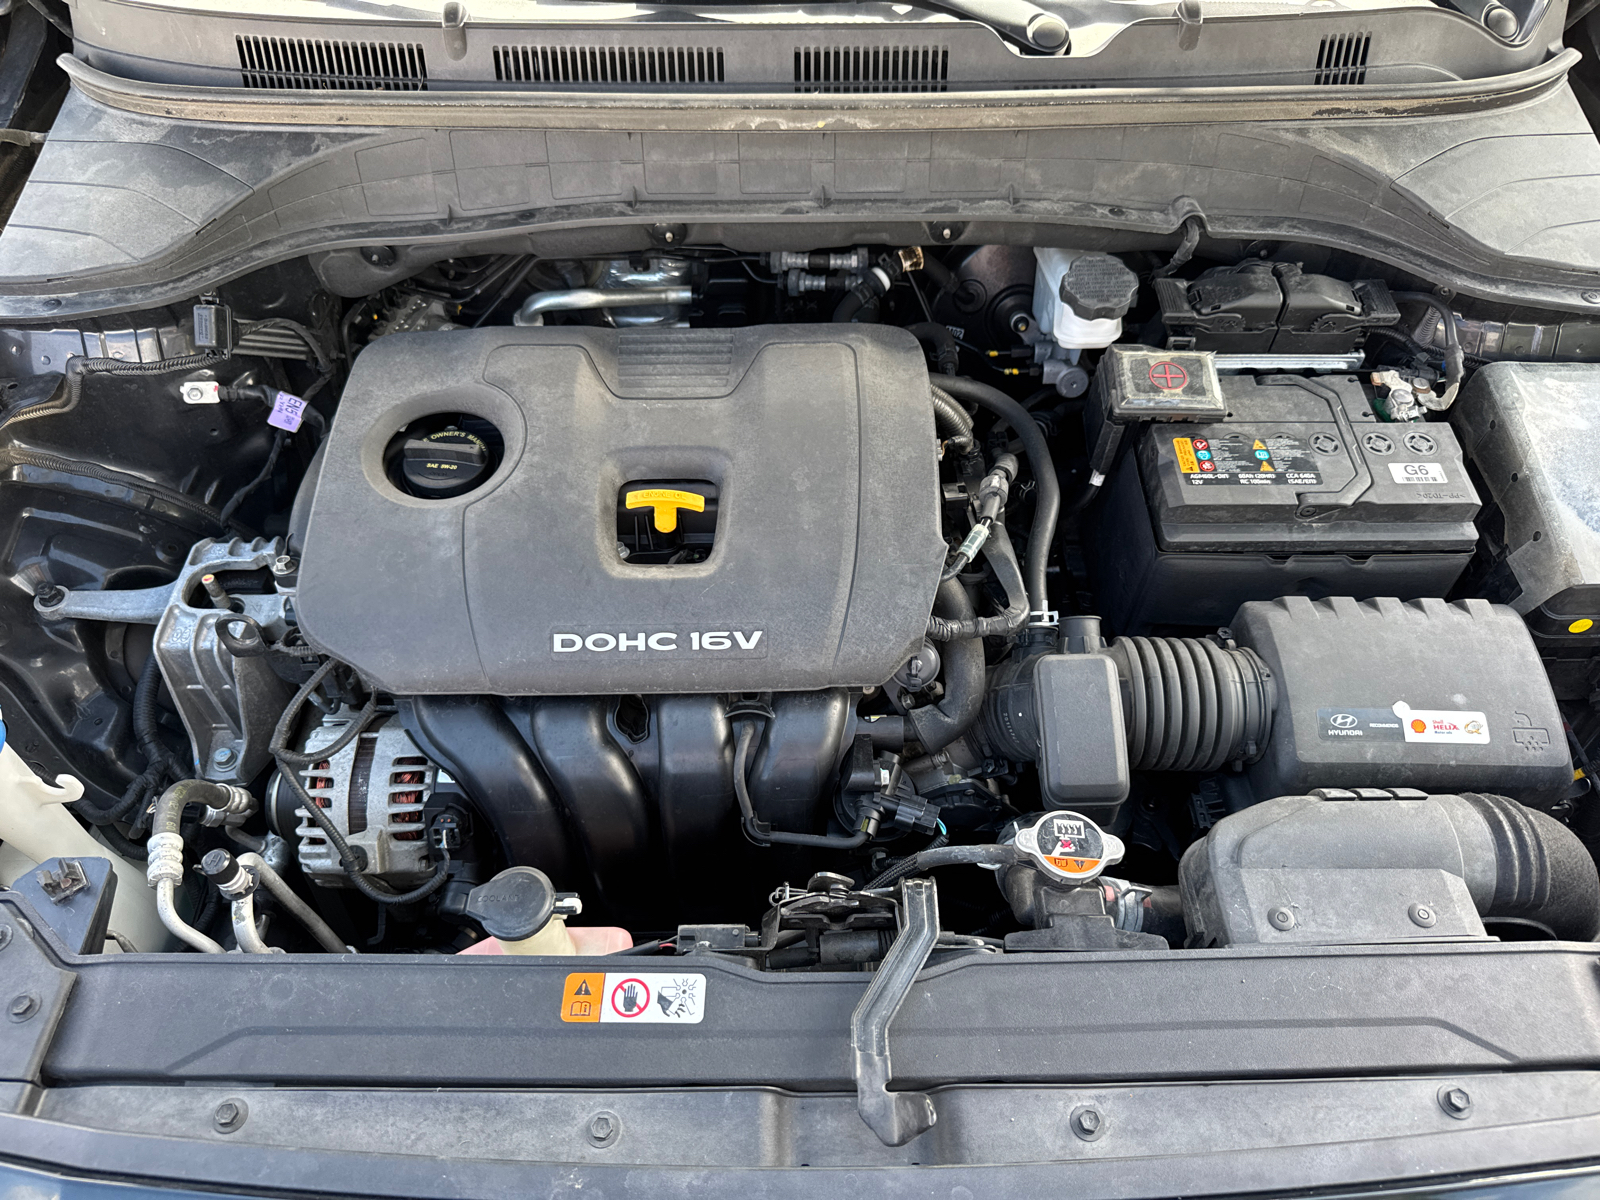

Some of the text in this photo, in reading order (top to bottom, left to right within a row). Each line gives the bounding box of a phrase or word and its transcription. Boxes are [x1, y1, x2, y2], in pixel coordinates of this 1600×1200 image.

[430, 430, 466, 440] OWNER'S
[1404, 464, 1429, 476] G6
[553, 630, 763, 652] DOHC 16V
[1433, 723, 1460, 731] HELIX
